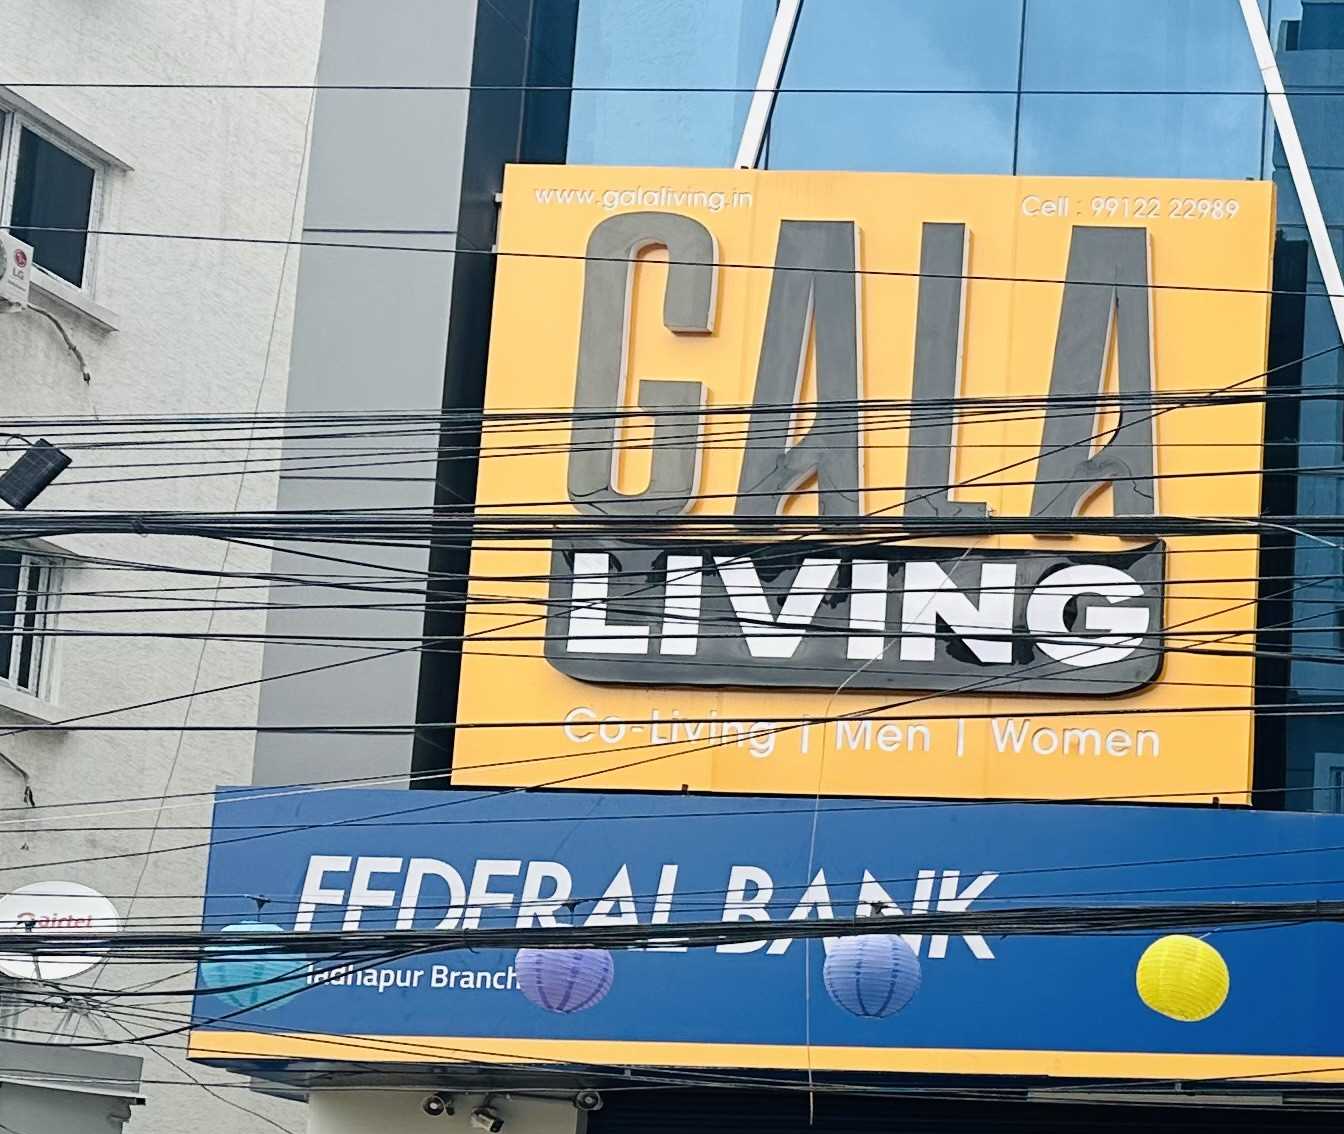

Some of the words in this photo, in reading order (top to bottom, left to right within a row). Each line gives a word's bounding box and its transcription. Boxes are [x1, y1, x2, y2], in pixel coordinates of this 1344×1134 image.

[533, 185, 754, 212] www.galaliving.in
[1020, 194, 1070, 217] Cell
[1089, 195, 1161, 218] 99122
[1167, 197, 1240, 221] 22989
[565, 210, 1160, 538] GALA
[566, 551, 1152, 668] LIVING
[563, 706, 778, 758] Co-Living
[835, 718, 932, 755] Men
[992, 718, 1162, 759] Women
[293, 854, 690, 953] FEDERAL
[715, 864, 1000, 960] BANK
[306, 962, 425, 993] adhapur
[430, 965, 520, 991] Branch
